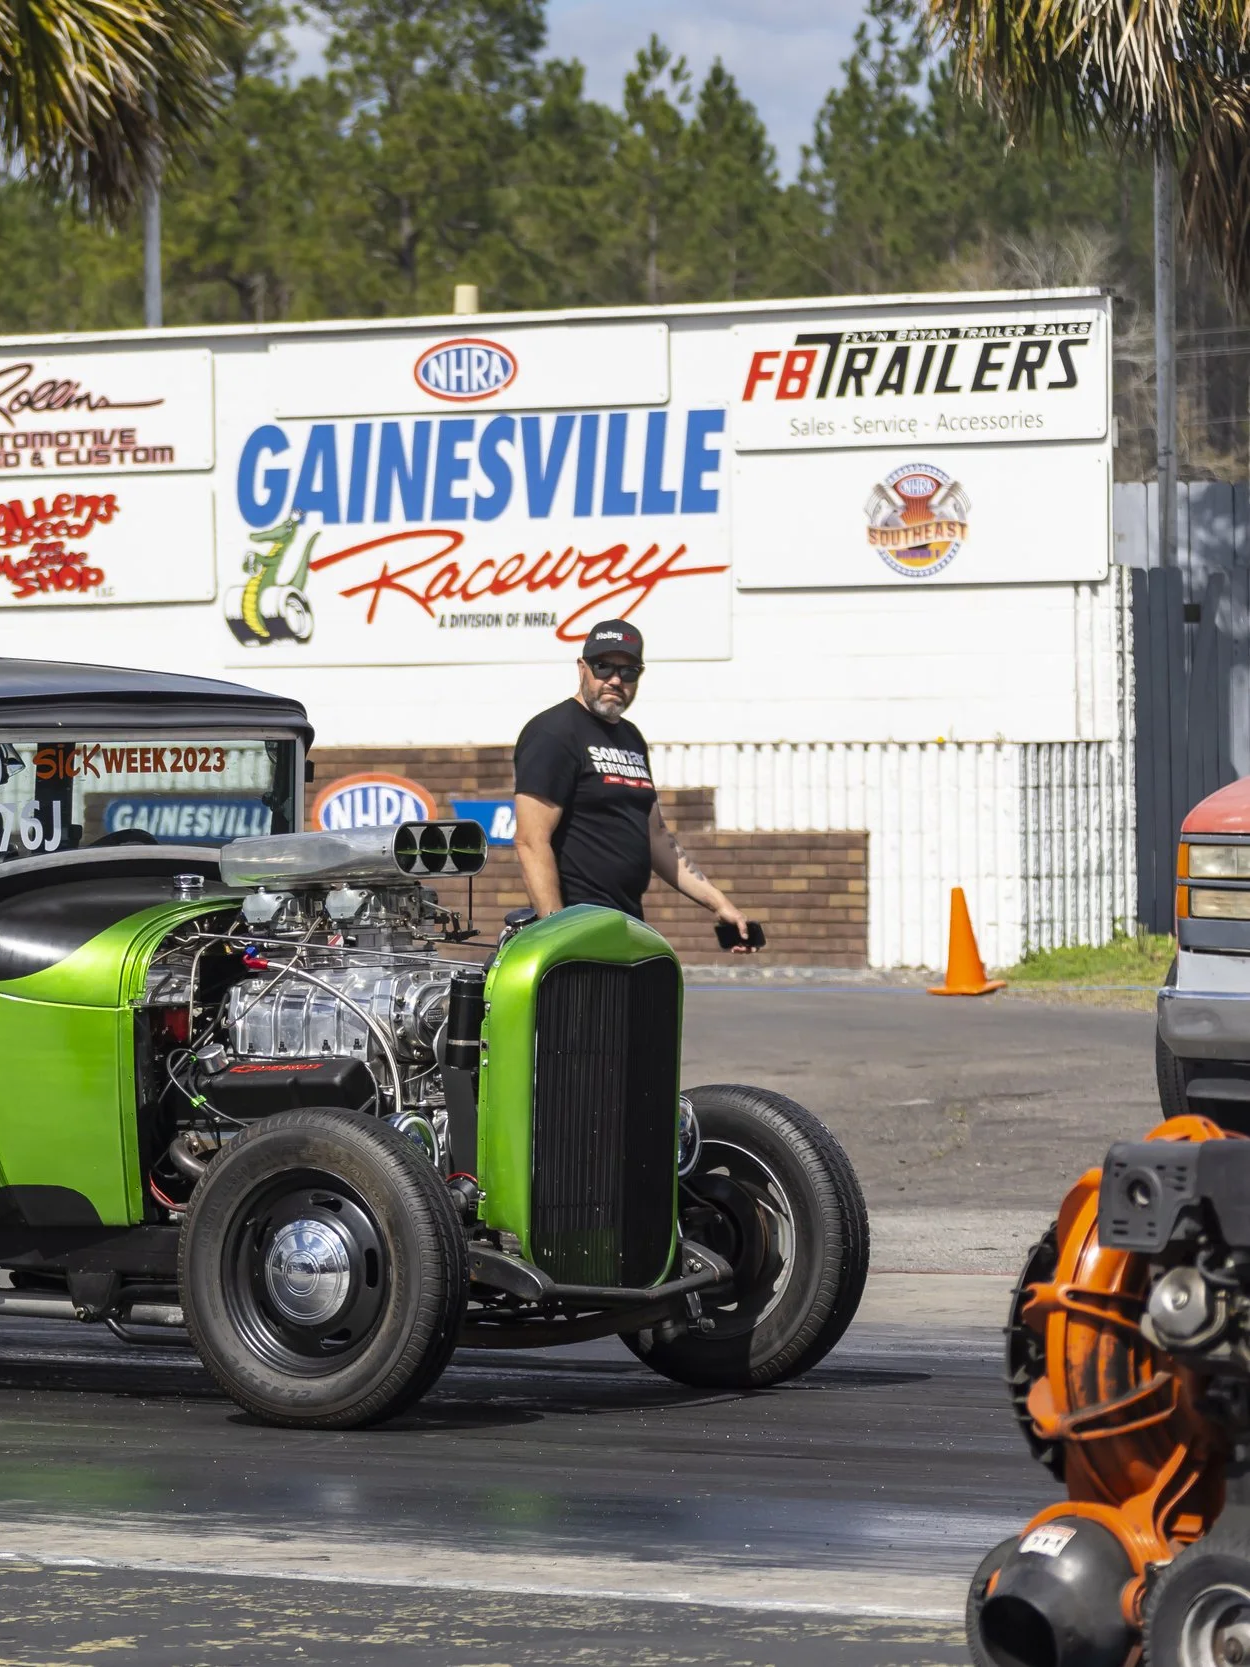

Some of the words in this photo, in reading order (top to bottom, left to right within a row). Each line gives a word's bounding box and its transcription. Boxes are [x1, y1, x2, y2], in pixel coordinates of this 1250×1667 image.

[895, 328, 951, 341] BRYAN
[958, 326, 1027, 339] TRAILER
[1032, 323, 1091, 335] SALES
[427, 346, 507, 393] NHRA
[790, 417, 835, 438] Sales
[853, 414, 918, 435] Service
[937, 409, 1045, 433] Accessories
[31, 451, 45, 468] &
[55, 446, 174, 466] CUSTOM
[236, 409, 727, 528] GAINESVILLE
[901, 478, 935, 496] NHRA
[868, 520, 968, 546] SOUTHEAST
[11, 565, 105, 599] SHOP
[309, 529, 731, 643] Raceway
[439, 614, 446, 628] A
[450, 613, 503, 628] DIVISION
[506, 612, 521, 627] OF
[524, 612, 558, 627] NHRA
